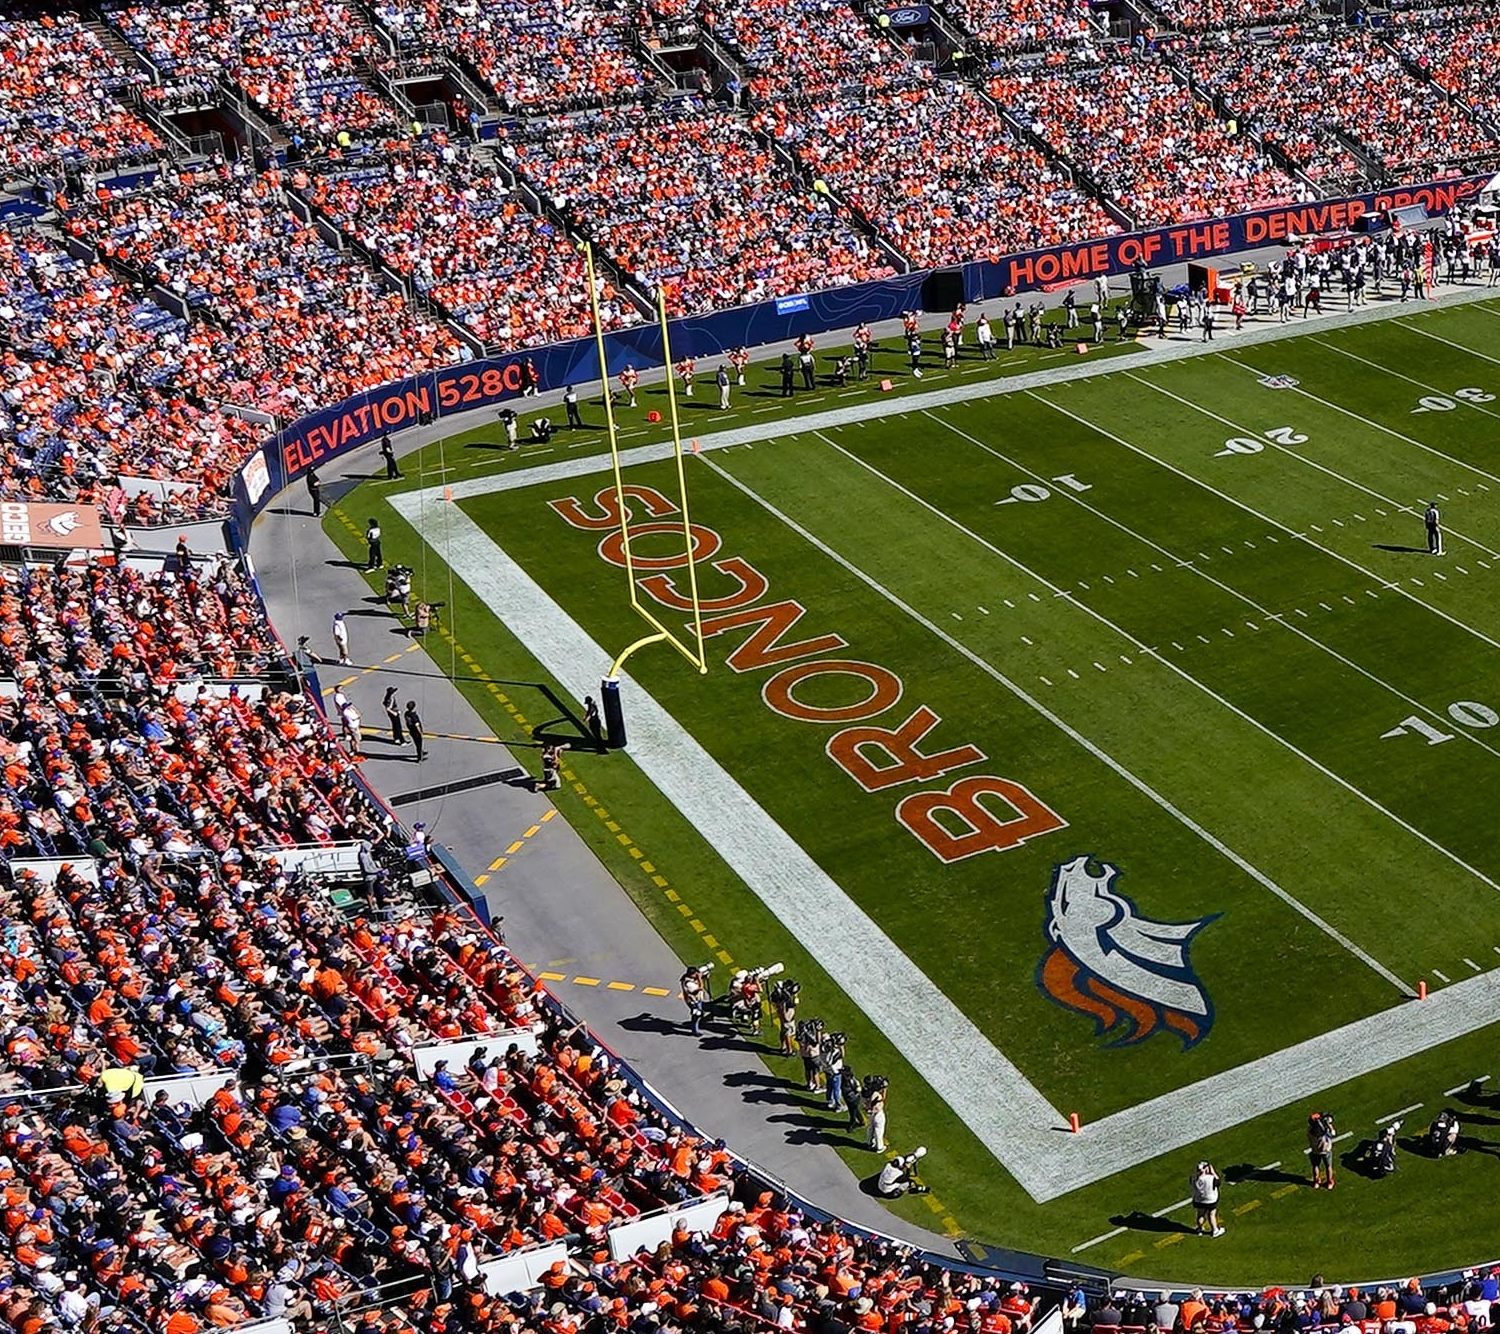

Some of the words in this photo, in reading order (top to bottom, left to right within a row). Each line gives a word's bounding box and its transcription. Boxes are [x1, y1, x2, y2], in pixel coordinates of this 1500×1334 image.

[1009, 243, 1108, 286] HOME
[1119, 237, 1161, 269] OF
[1170, 222, 1230, 257] THE
[1245, 201, 1364, 242] DENVER
[284, 386, 431, 475] ELEVATION
[440, 363, 521, 409] 5280
[1426, 387, 1497, 413] 30
[1231, 424, 1310, 457] 20
[1010, 471, 1093, 504] 10
[2, 503, 31, 544] GEICO
[548, 483, 1070, 864] BRONCOS
[1400, 700, 1500, 746] 10
